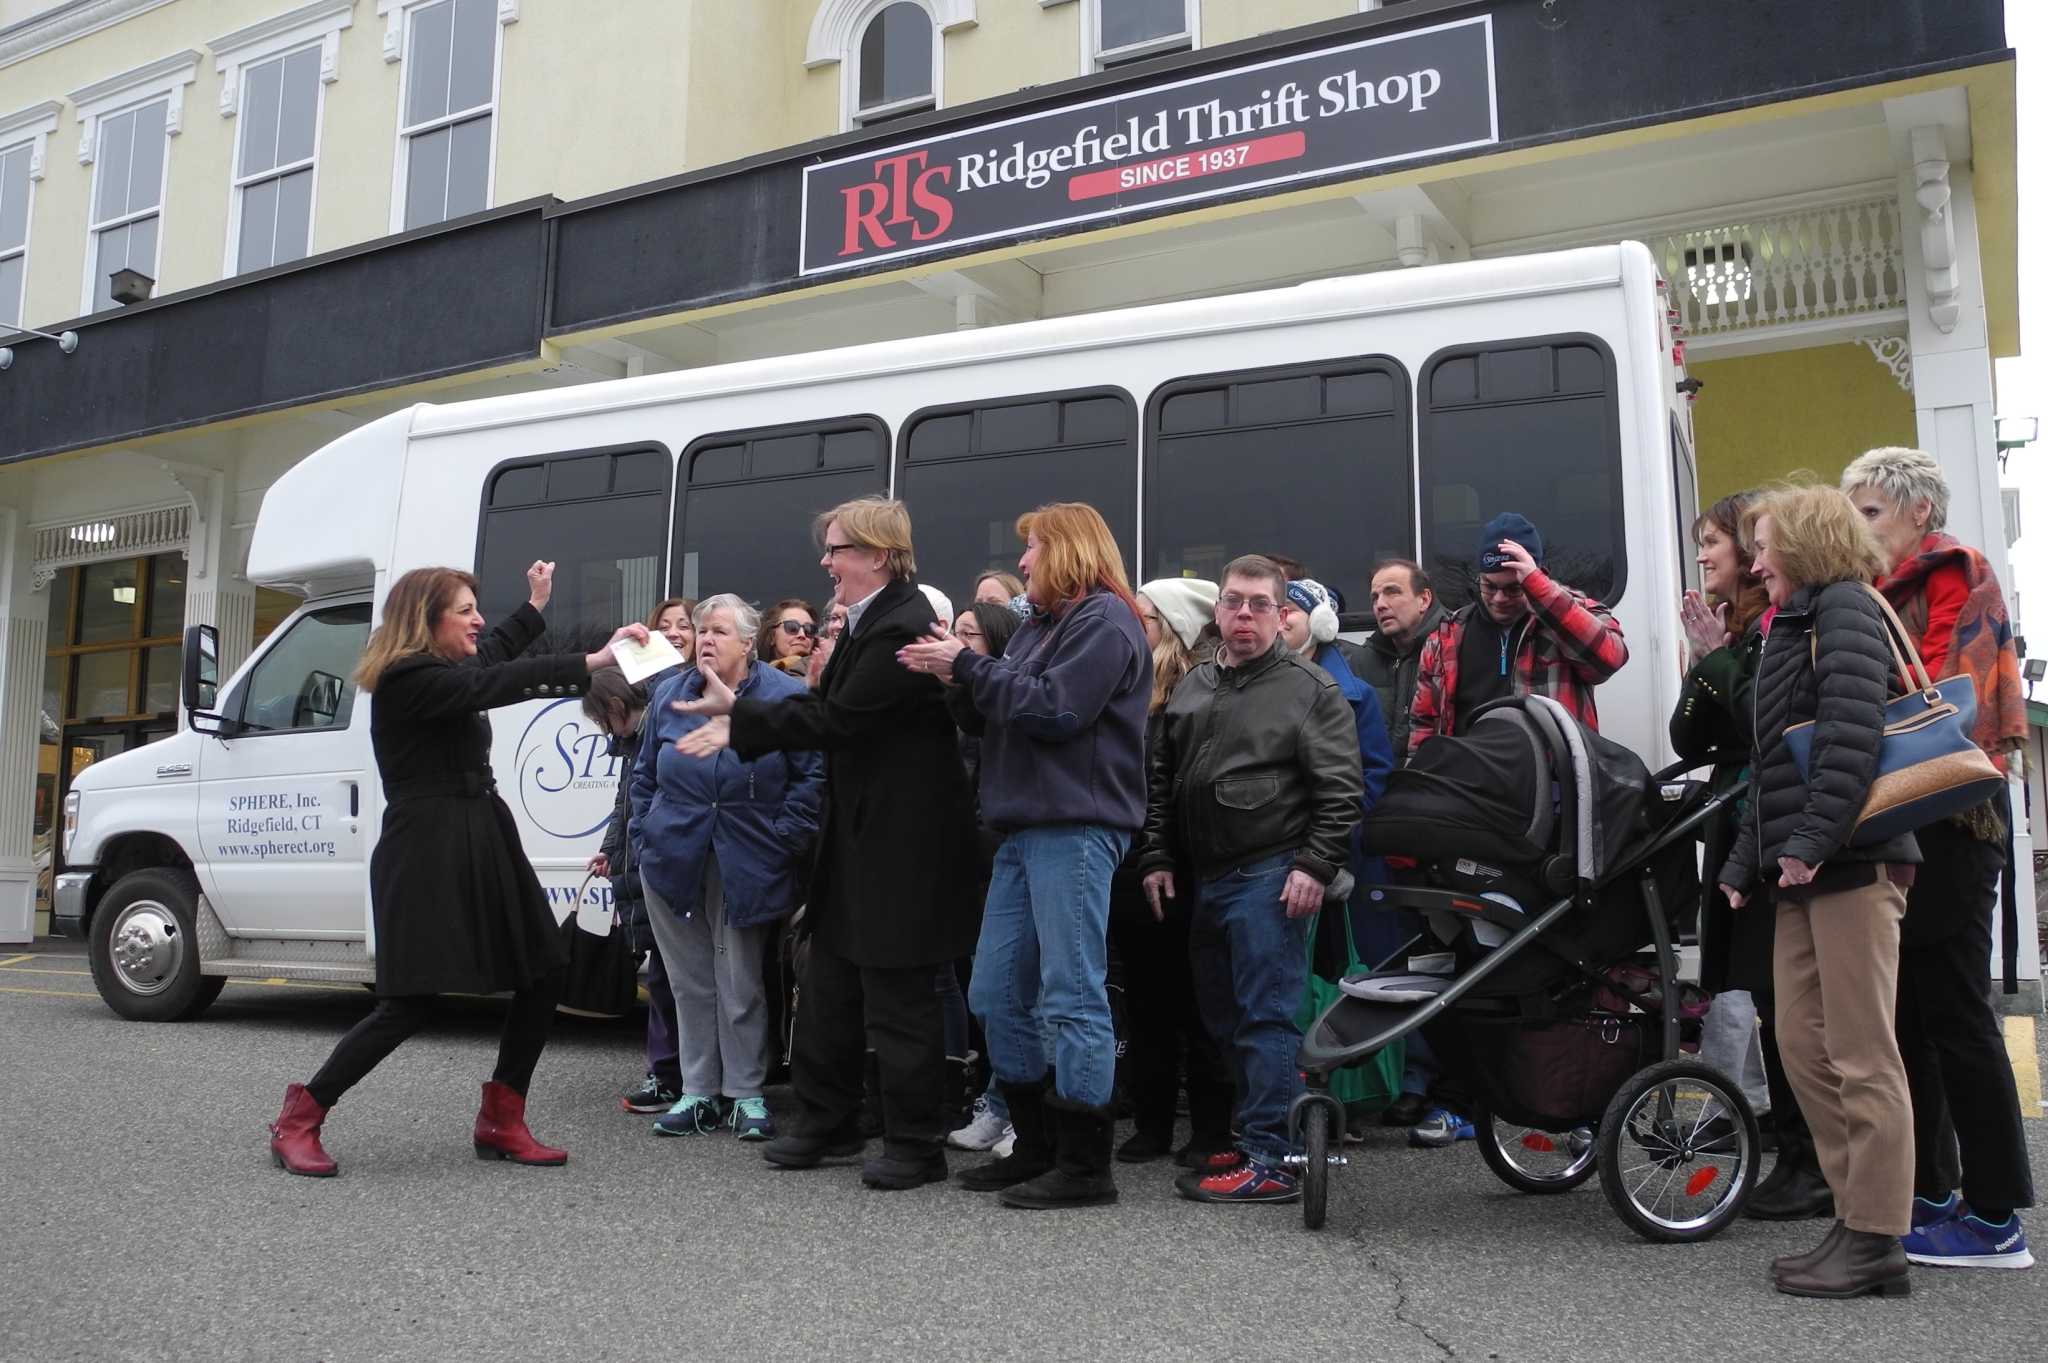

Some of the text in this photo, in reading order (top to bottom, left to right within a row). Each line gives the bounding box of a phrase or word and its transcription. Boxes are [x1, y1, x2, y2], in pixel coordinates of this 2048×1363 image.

[956, 68, 1441, 193] Ridgefield Thrift Shop
[1120, 145, 1250, 188] SINCE 1937
[837, 150, 953, 256] RTS
[573, 781, 609, 790] CREATING
[229, 793, 321, 811] SPHERE, Inc.
[227, 815, 322, 836] Ridgefield, CT
[218, 840, 336, 859] www.spherect.org
